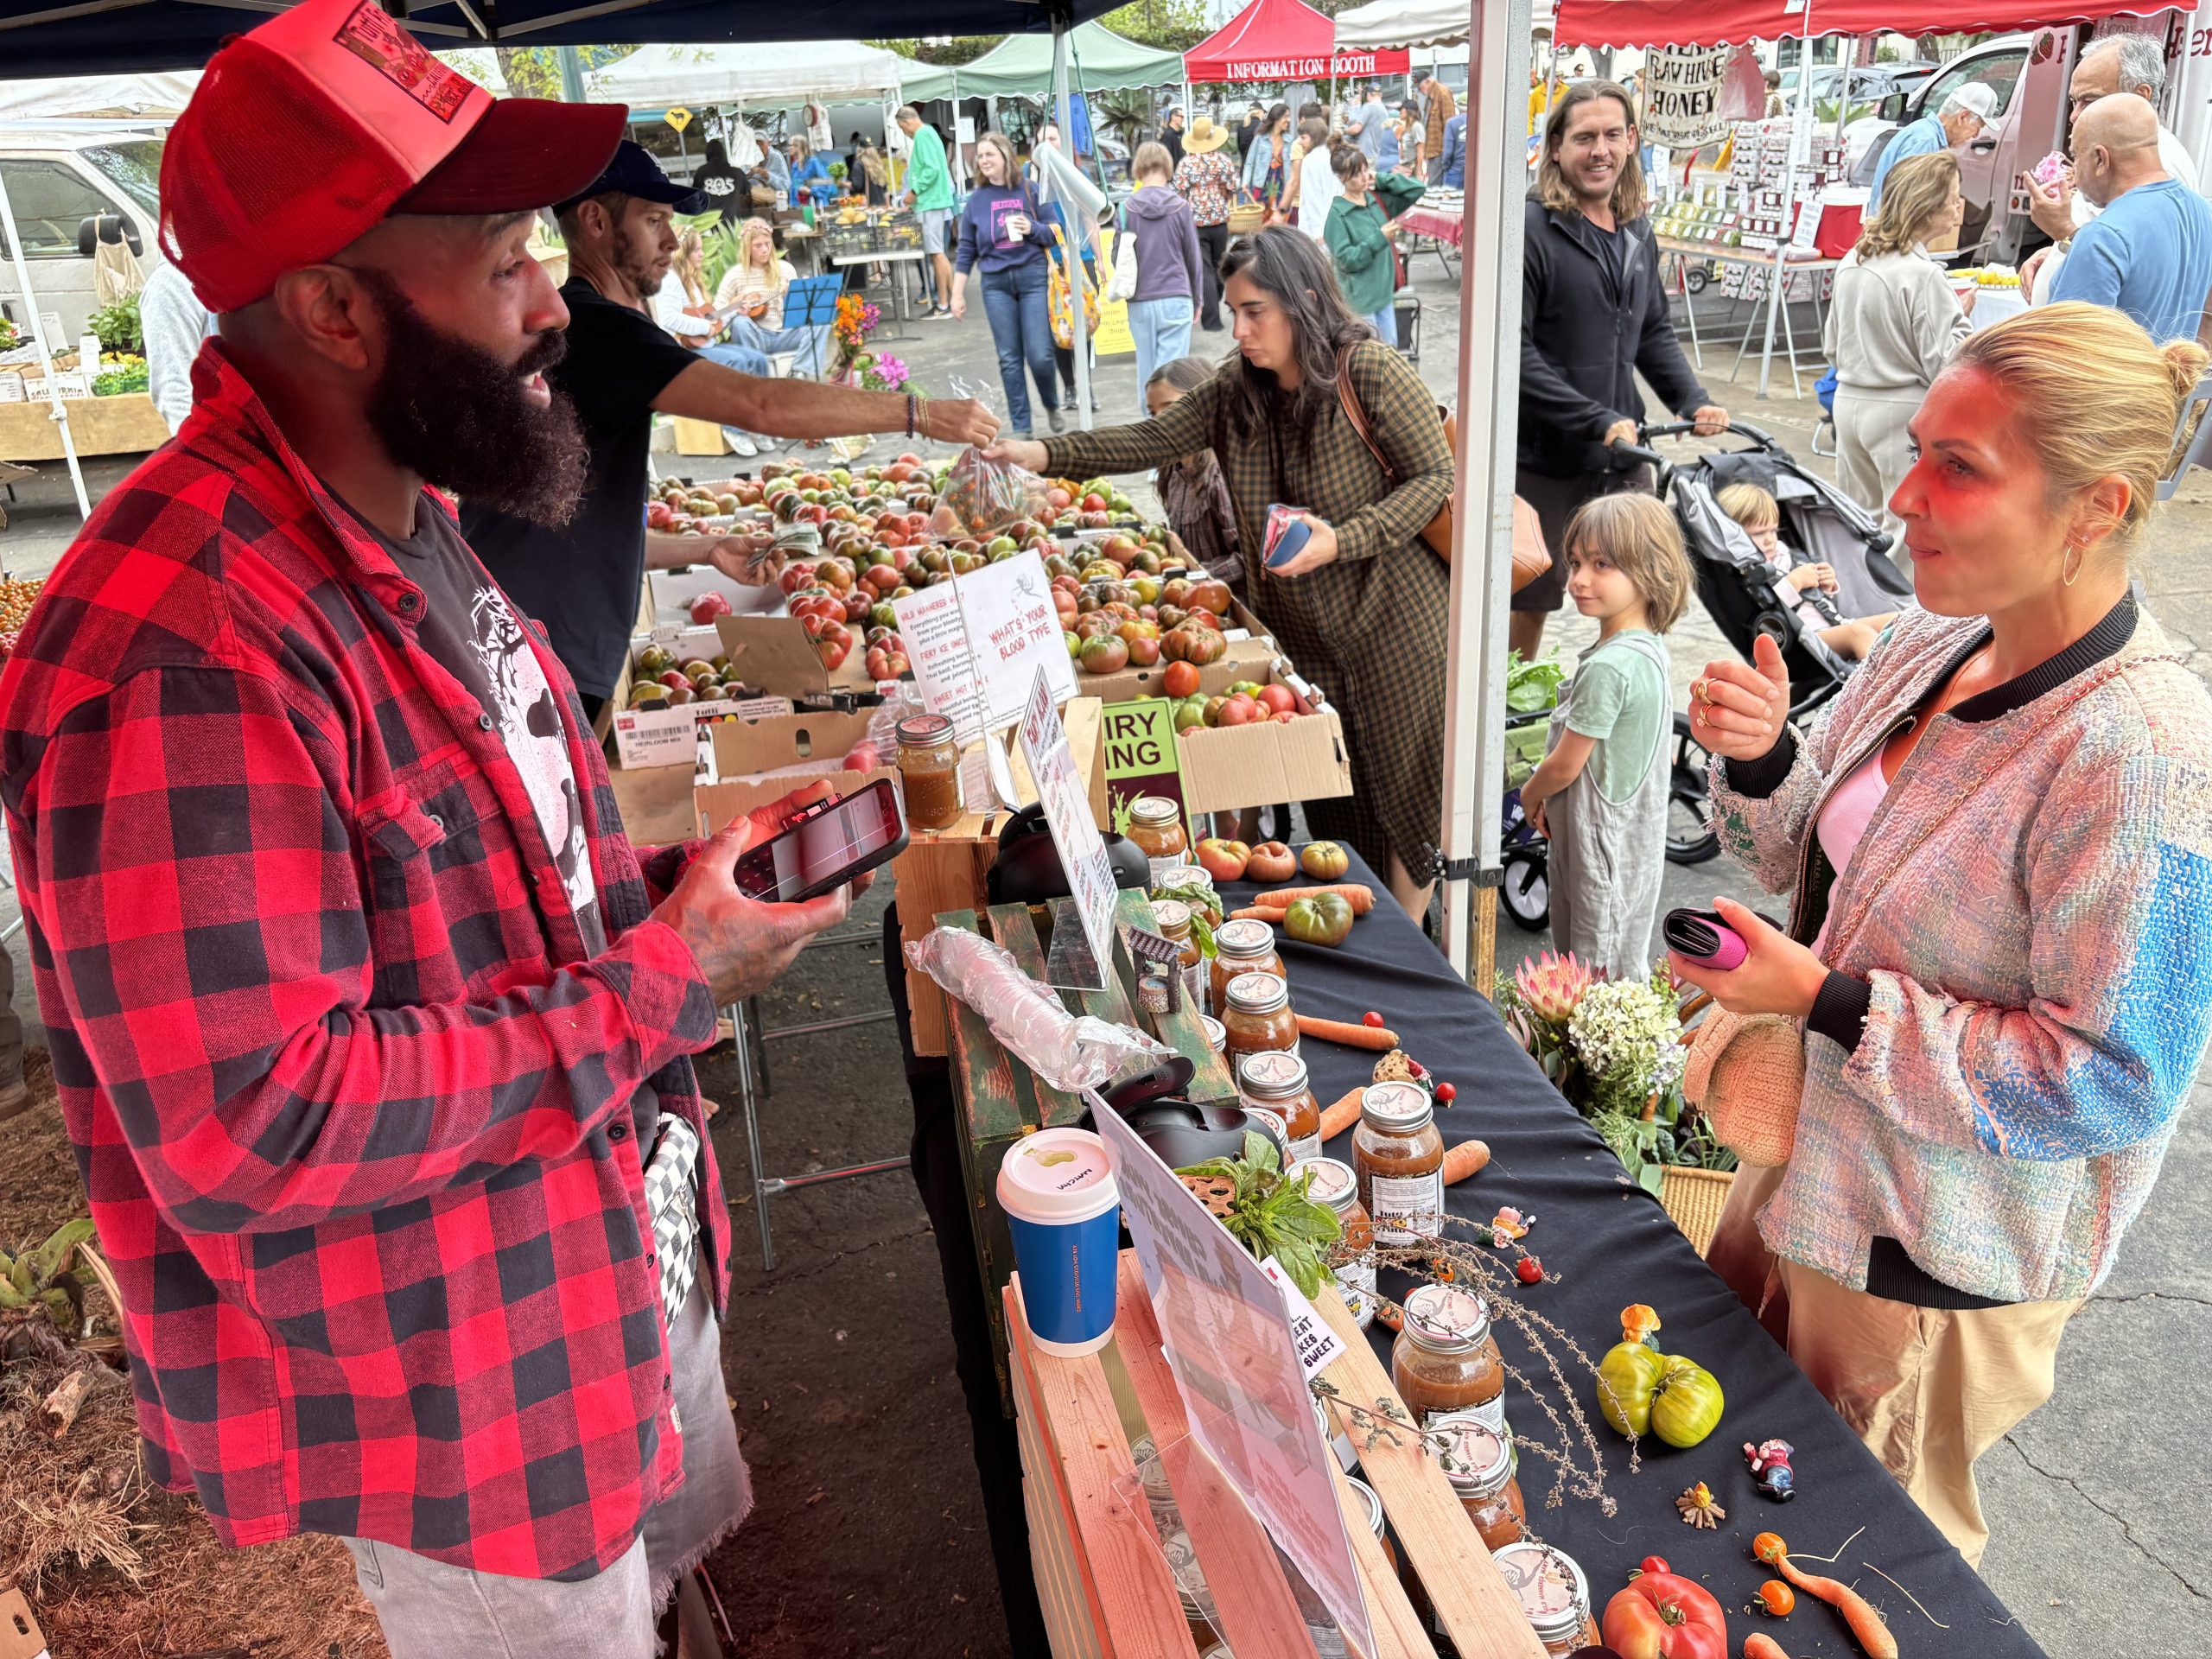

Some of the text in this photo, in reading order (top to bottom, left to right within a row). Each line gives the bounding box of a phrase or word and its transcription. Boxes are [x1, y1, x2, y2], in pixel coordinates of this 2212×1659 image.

[1226, 55, 1376, 79] INFORMATION BOOTH
[1654, 86, 1719, 118] HONEY
[703, 176, 735, 193] 805
[917, 598, 947, 617] MANNERED
[910, 612, 939, 632] Everything
[939, 611, 950, 622] you
[917, 626, 930, 638] from
[931, 623, 943, 635] your
[988, 604, 1048, 645] WHAT'S YOUR
[918, 636, 931, 647] plus
[999, 621, 1052, 662] BLOOD TYPE
[927, 656, 956, 671] Refreshing
[926, 671, 938, 681] Thai
[940, 675, 950, 684] and
[933, 690, 953, 707] SWEET
[955, 684, 969, 696] HOT
[938, 700, 963, 715] Beautiful
[1105, 710, 1158, 741] IRY
[634, 736, 682, 748] HEIRLOOM MIX
[1293, 1316, 1313, 1338] EAT
[1298, 1333, 1318, 1355] KES
[1303, 1335, 1335, 1367] SWEET
[1541, 1560, 1549, 1574] MARY
